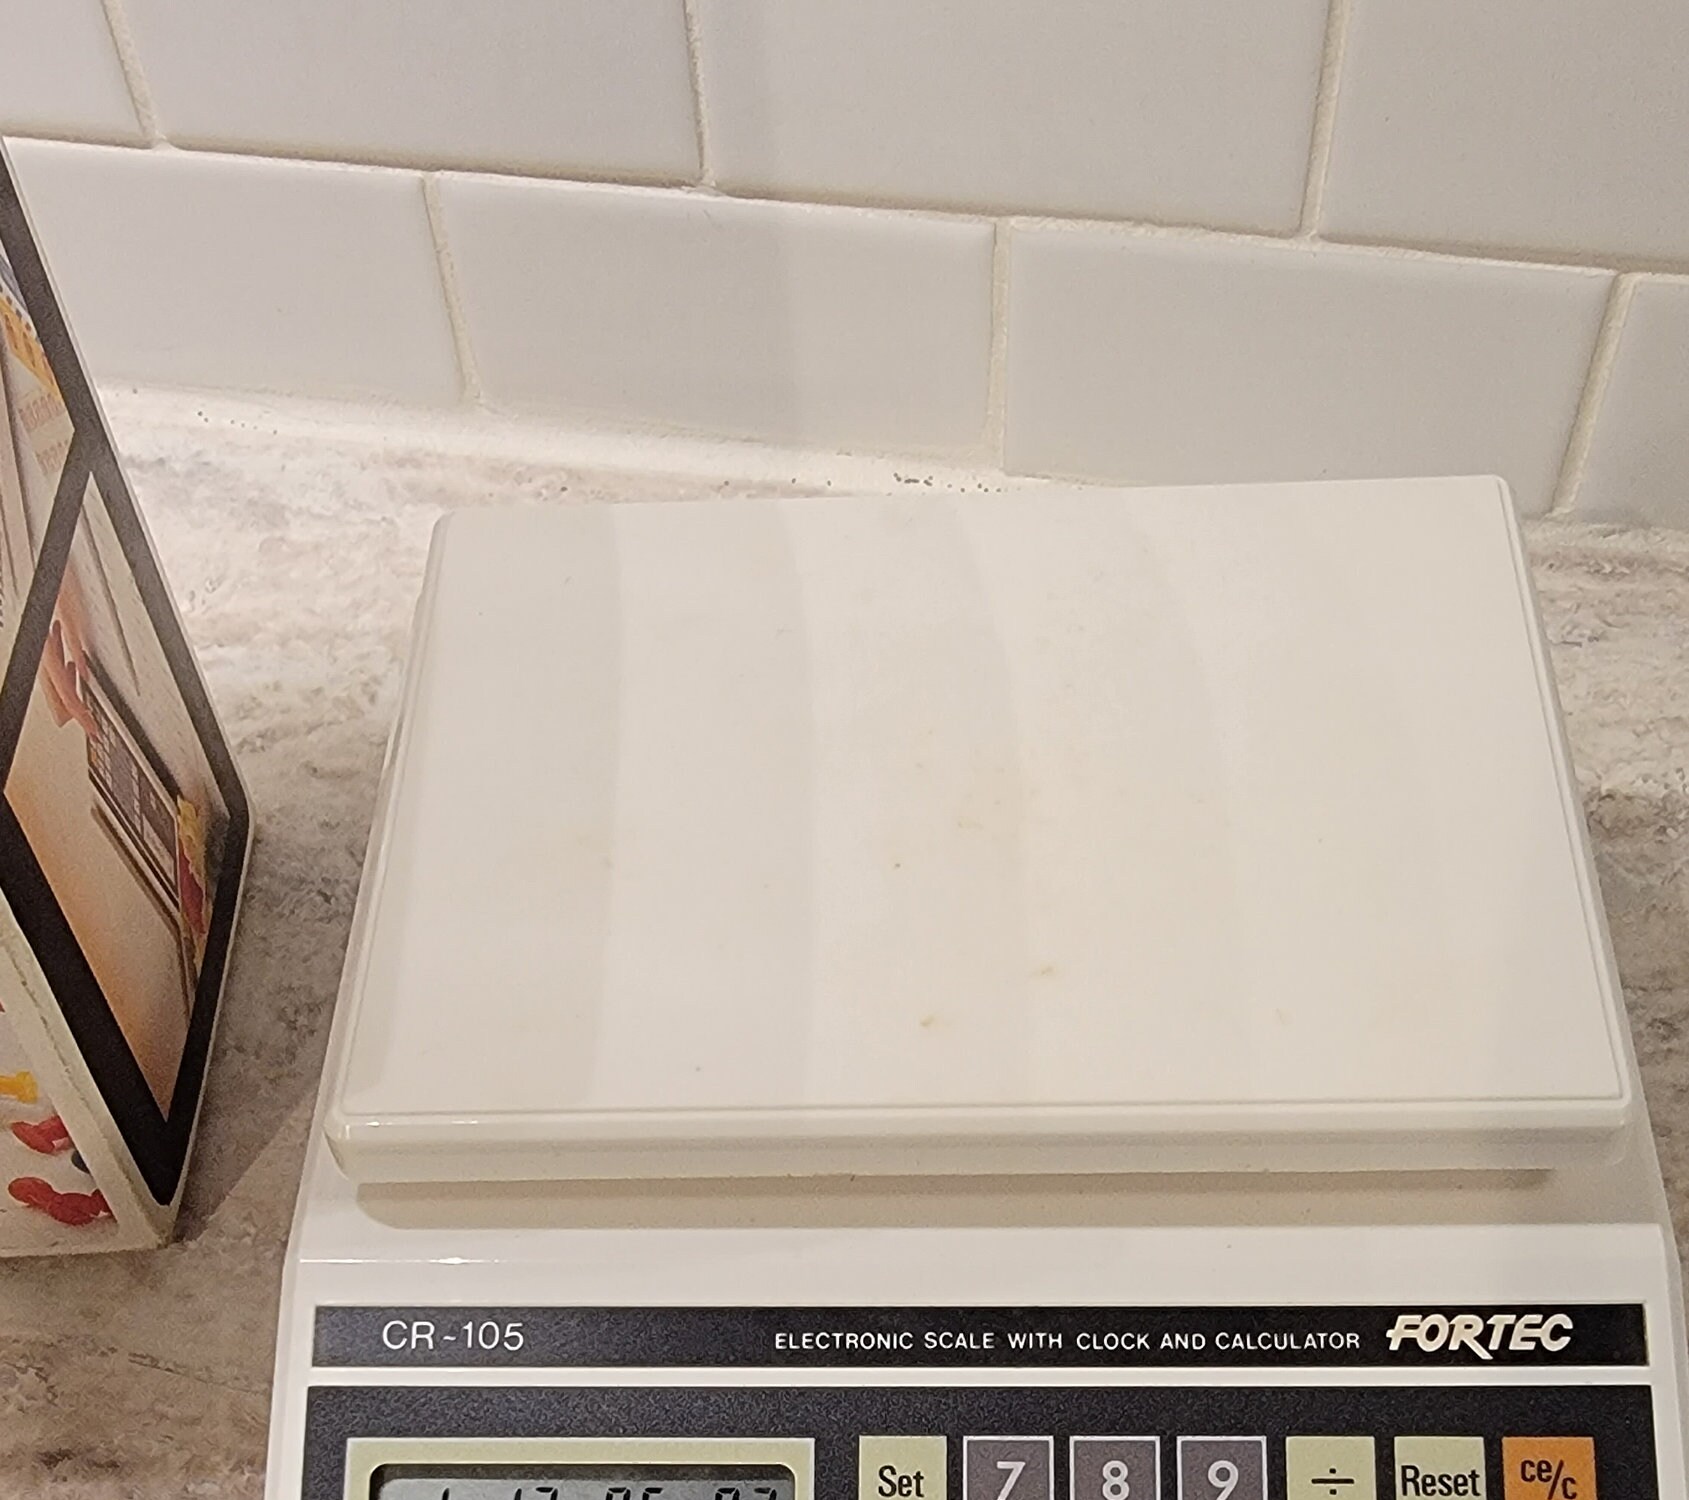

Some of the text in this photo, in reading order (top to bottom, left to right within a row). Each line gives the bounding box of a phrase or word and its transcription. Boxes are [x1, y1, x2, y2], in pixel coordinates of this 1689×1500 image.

[382, 1320, 524, 1351] CR-105
[775, 1331, 1360, 1351] ELECTRONIC SCALE WITH CLOCK AND CALCULATOR
[1385, 1313, 1574, 1360] FORTEC
[878, 1465, 925, 1498] Set
[1401, 1464, 1481, 1497] Reset
